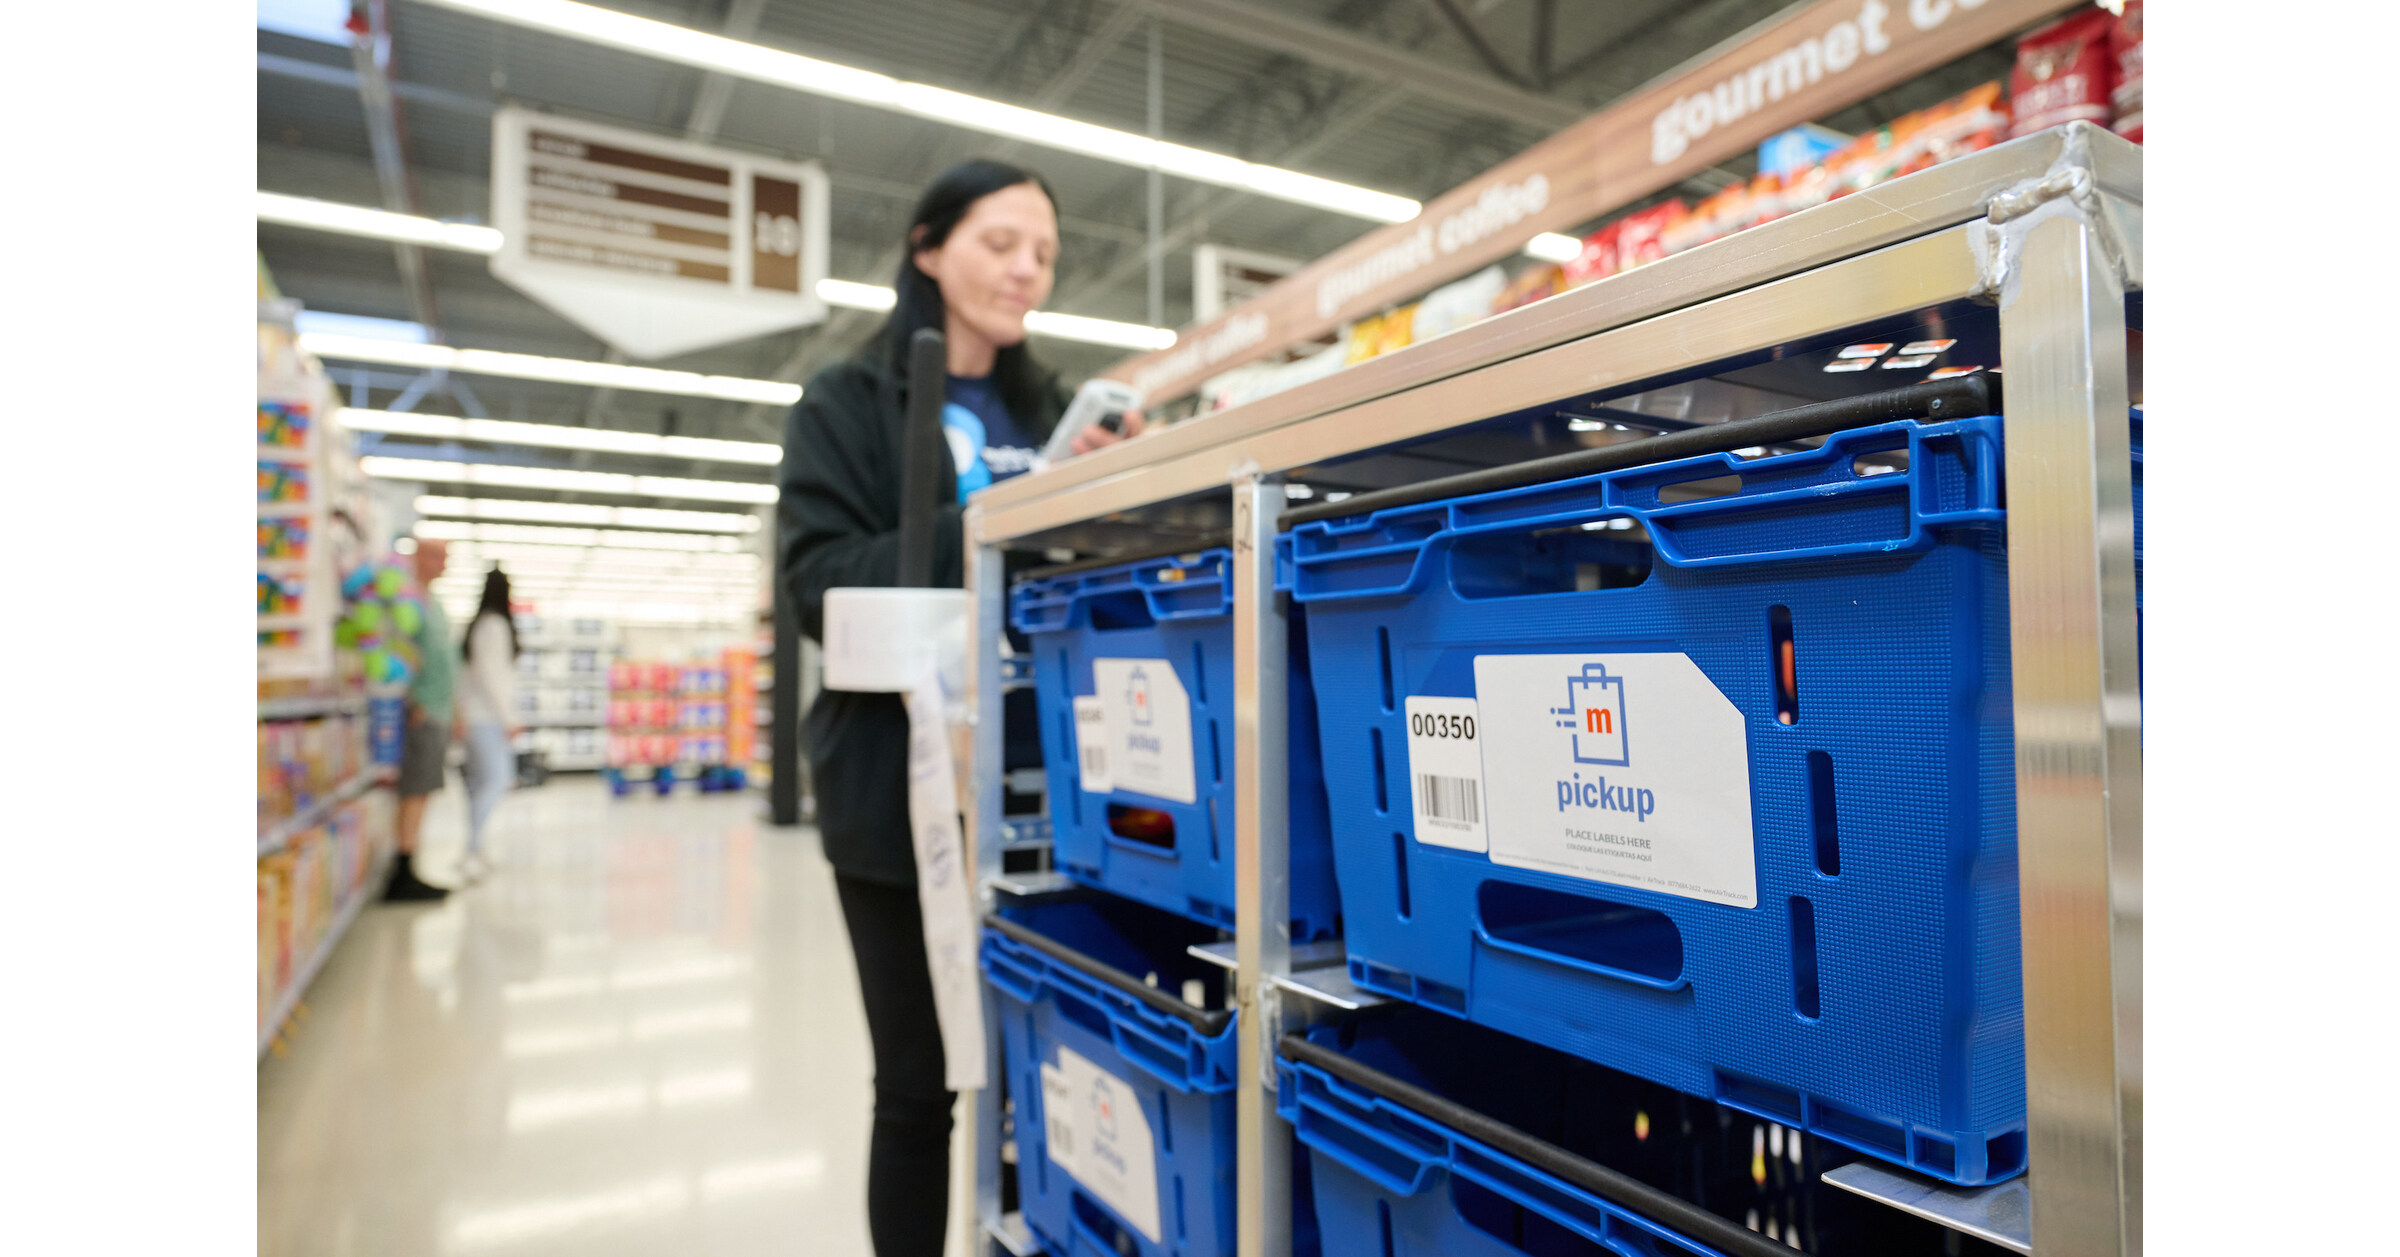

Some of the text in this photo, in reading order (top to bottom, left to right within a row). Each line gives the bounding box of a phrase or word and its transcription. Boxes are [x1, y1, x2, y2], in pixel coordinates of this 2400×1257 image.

[1650, 0, 1890, 165] gourmet
[1316, 173, 1549, 318] gourmet coffee
[1412, 713, 1476, 740] 00350
[1586, 707, 1613, 734] m
[1556, 772, 1656, 823] pickup
[1565, 828, 1652, 850] PLACE LABELS HERE
